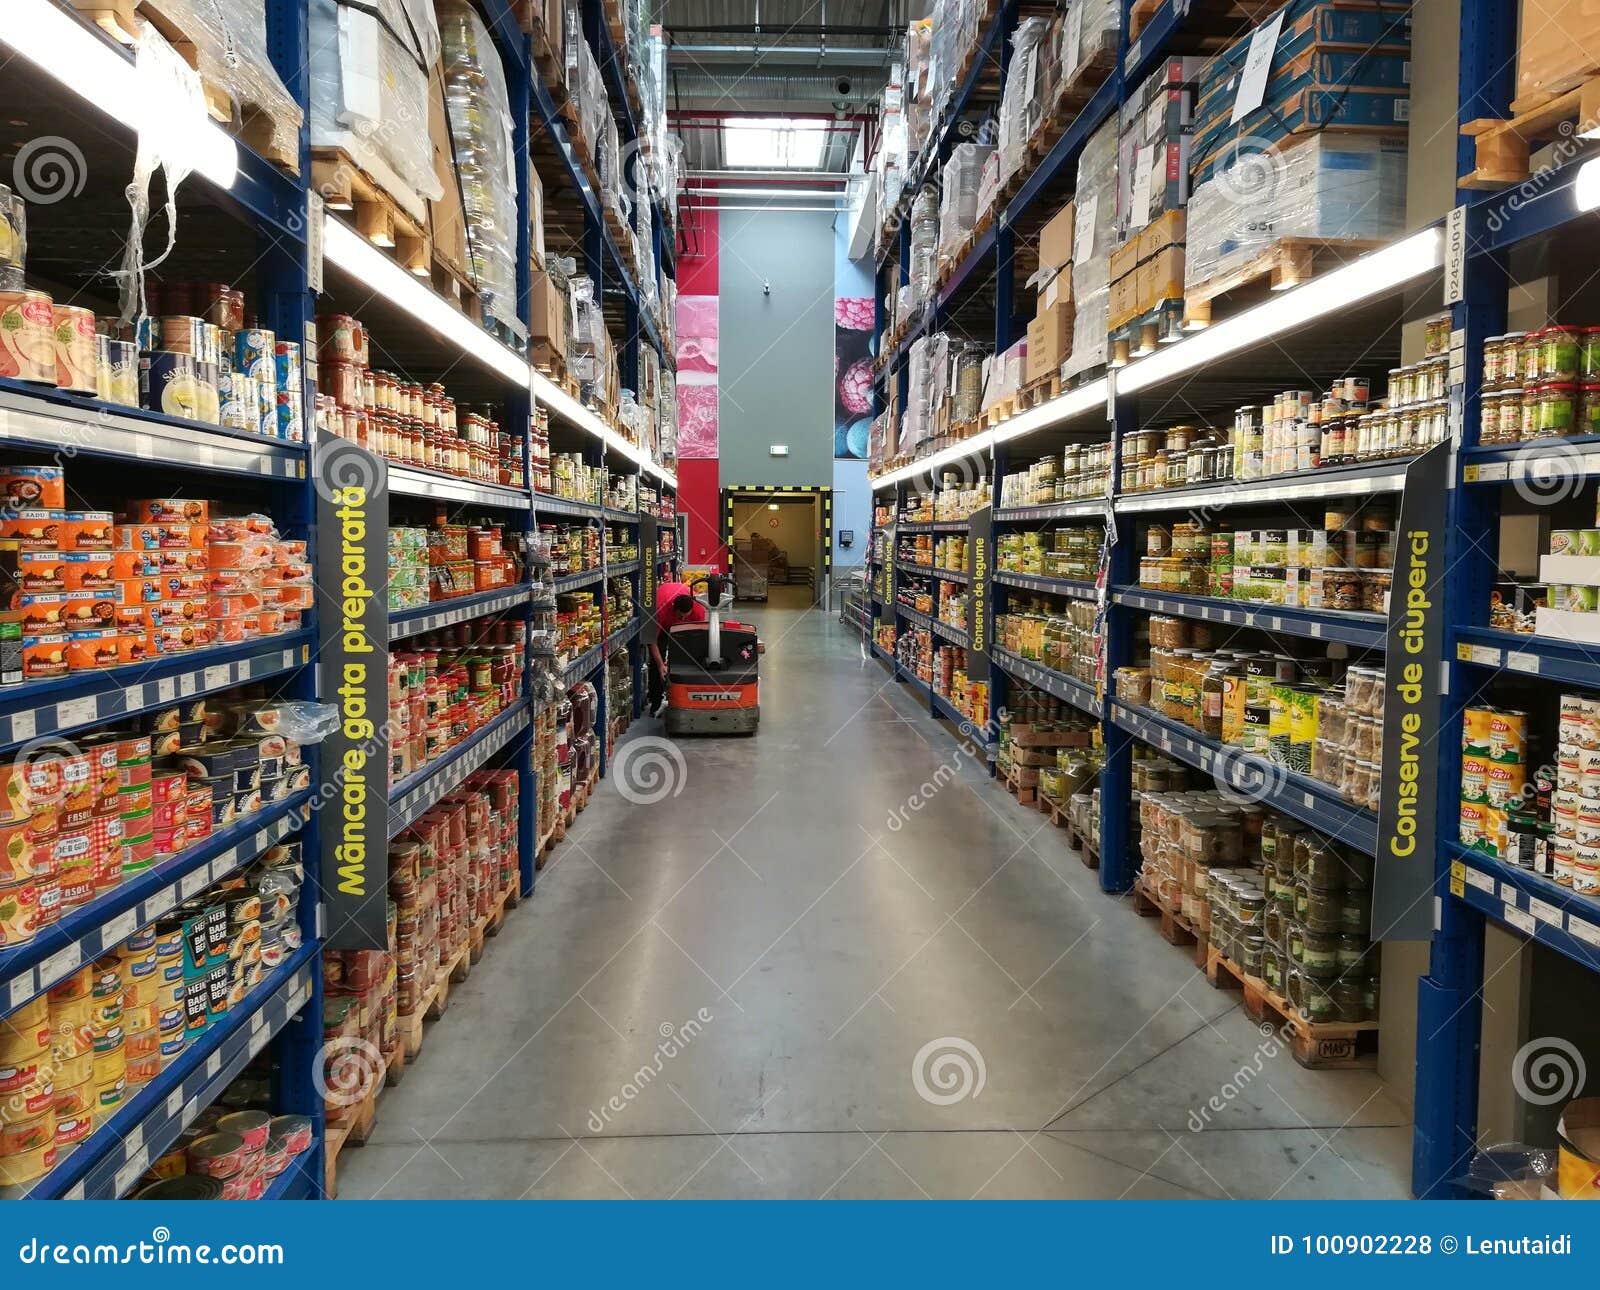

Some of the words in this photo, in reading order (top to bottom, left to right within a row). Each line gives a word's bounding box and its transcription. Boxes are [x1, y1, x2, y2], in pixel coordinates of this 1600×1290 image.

[1450, 209, 1463, 300] 0245-0018
[333, 486, 374, 653] preparată
[884, 541, 893, 562] fructe
[884, 563, 893, 573] de
[974, 537, 986, 581] legume
[645, 569, 653, 608] Conserve
[884, 574, 893, 605] Conserve
[973, 584, 984, 598] de
[1400, 531, 1431, 654] ciuperci
[973, 600, 984, 652] Conserve
[338, 663, 374, 740] gata
[691, 693, 739, 702] STILL
[1397, 664, 1423, 704] de
[1391, 714, 1420, 857] Conserve
[335, 750, 366, 896] Mâncare
[209, 911, 227, 923] HEIN
[188, 980, 206, 995] HEIN
